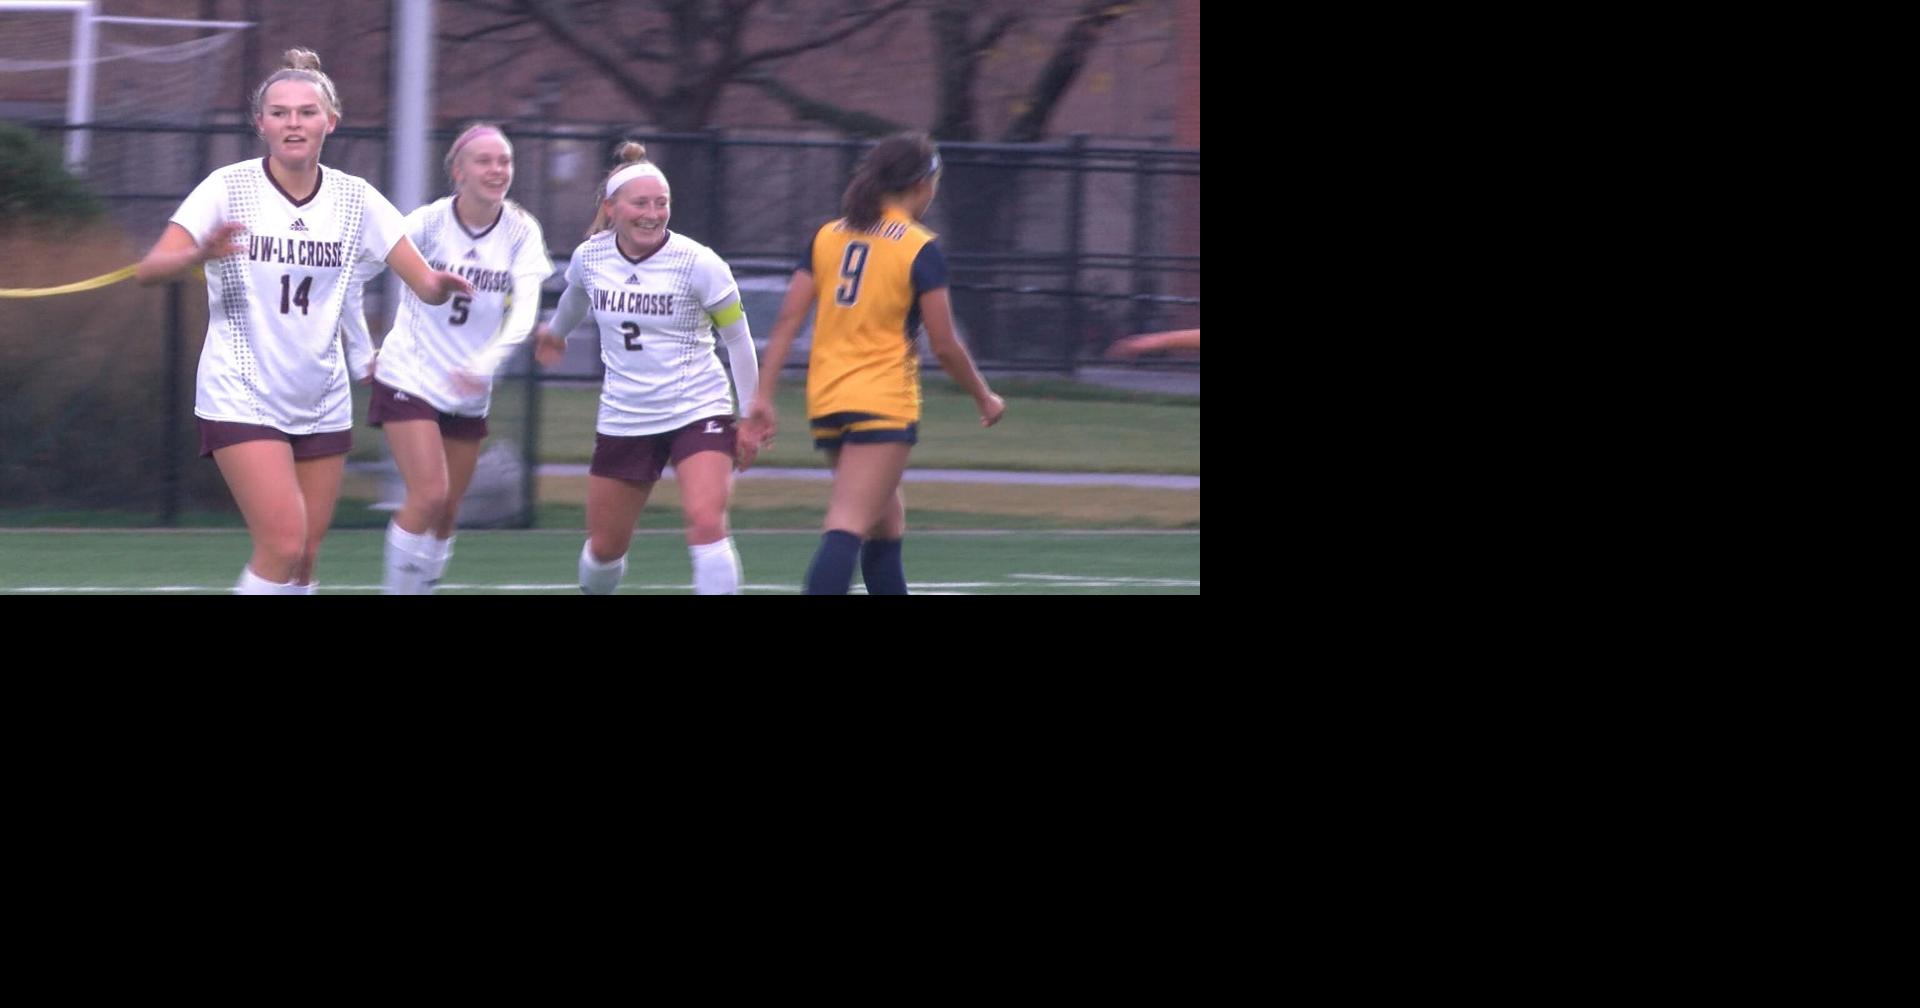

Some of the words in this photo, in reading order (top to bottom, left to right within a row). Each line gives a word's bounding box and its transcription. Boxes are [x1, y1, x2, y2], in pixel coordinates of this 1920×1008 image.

[249, 235, 295, 264] UW-LA
[836, 240, 870, 307] 9
[280, 274, 313, 316] 14
[447, 295, 473, 326] 5
[593, 288, 626, 312] UW-LA
[627, 292, 674, 315] CROSSE
[621, 320, 643, 351] 2
